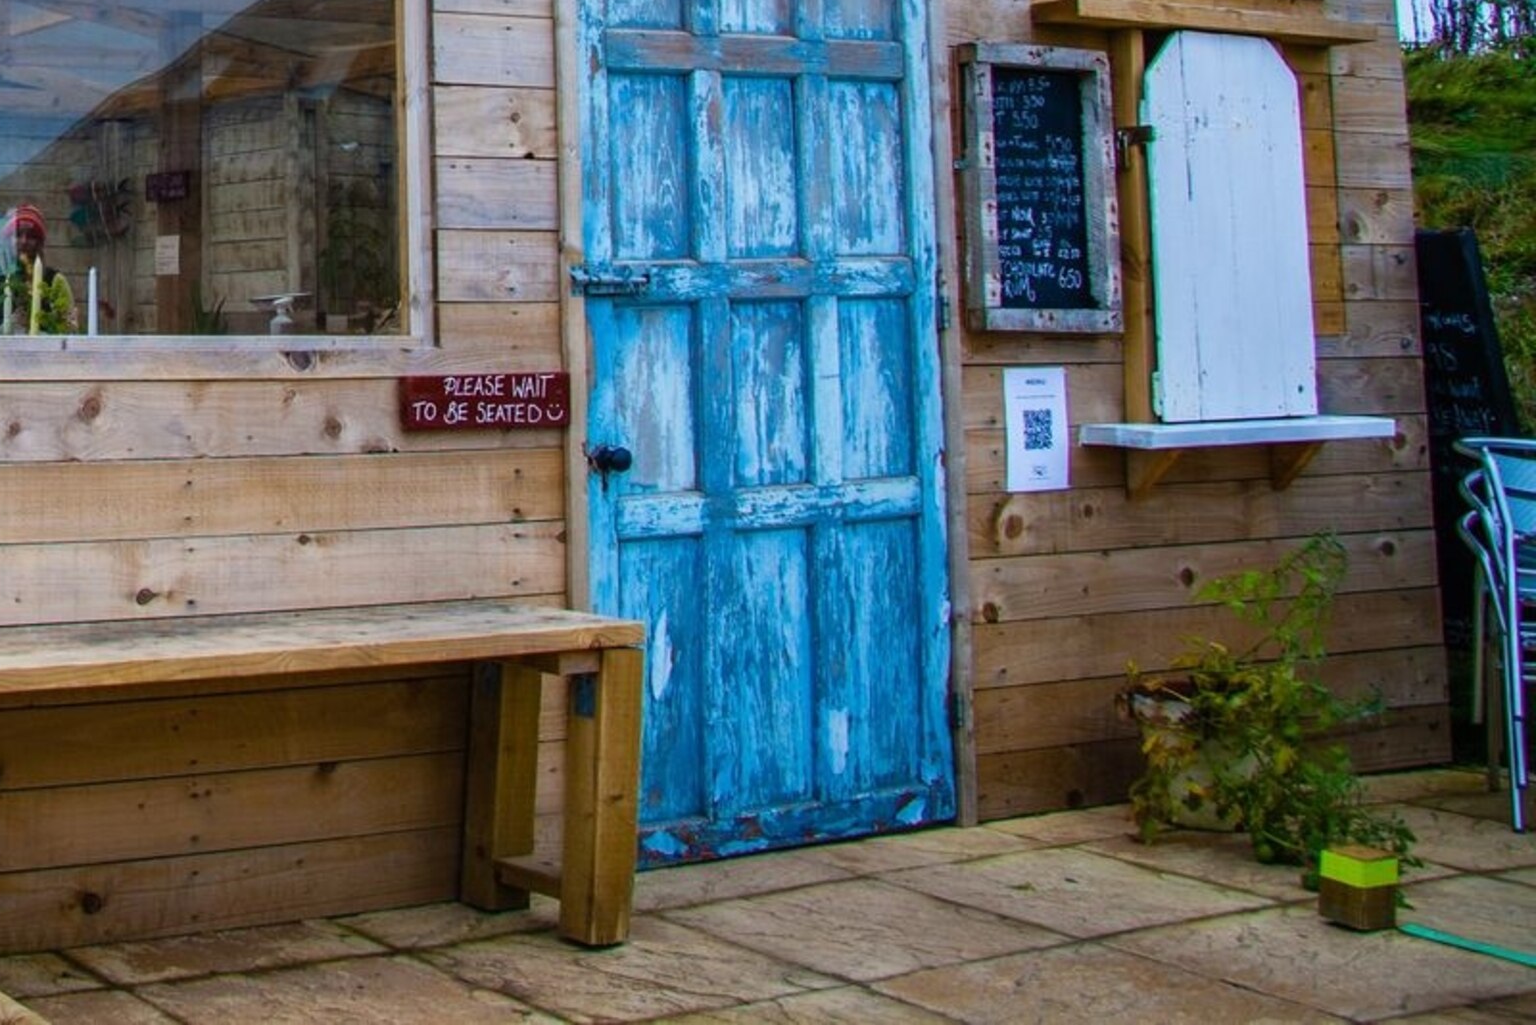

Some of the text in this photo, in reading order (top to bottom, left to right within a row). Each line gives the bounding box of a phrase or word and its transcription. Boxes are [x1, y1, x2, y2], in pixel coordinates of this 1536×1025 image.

[443, 374, 555, 398] PLEASE WAIT
[413, 401, 542, 424] TO BE SEATED
